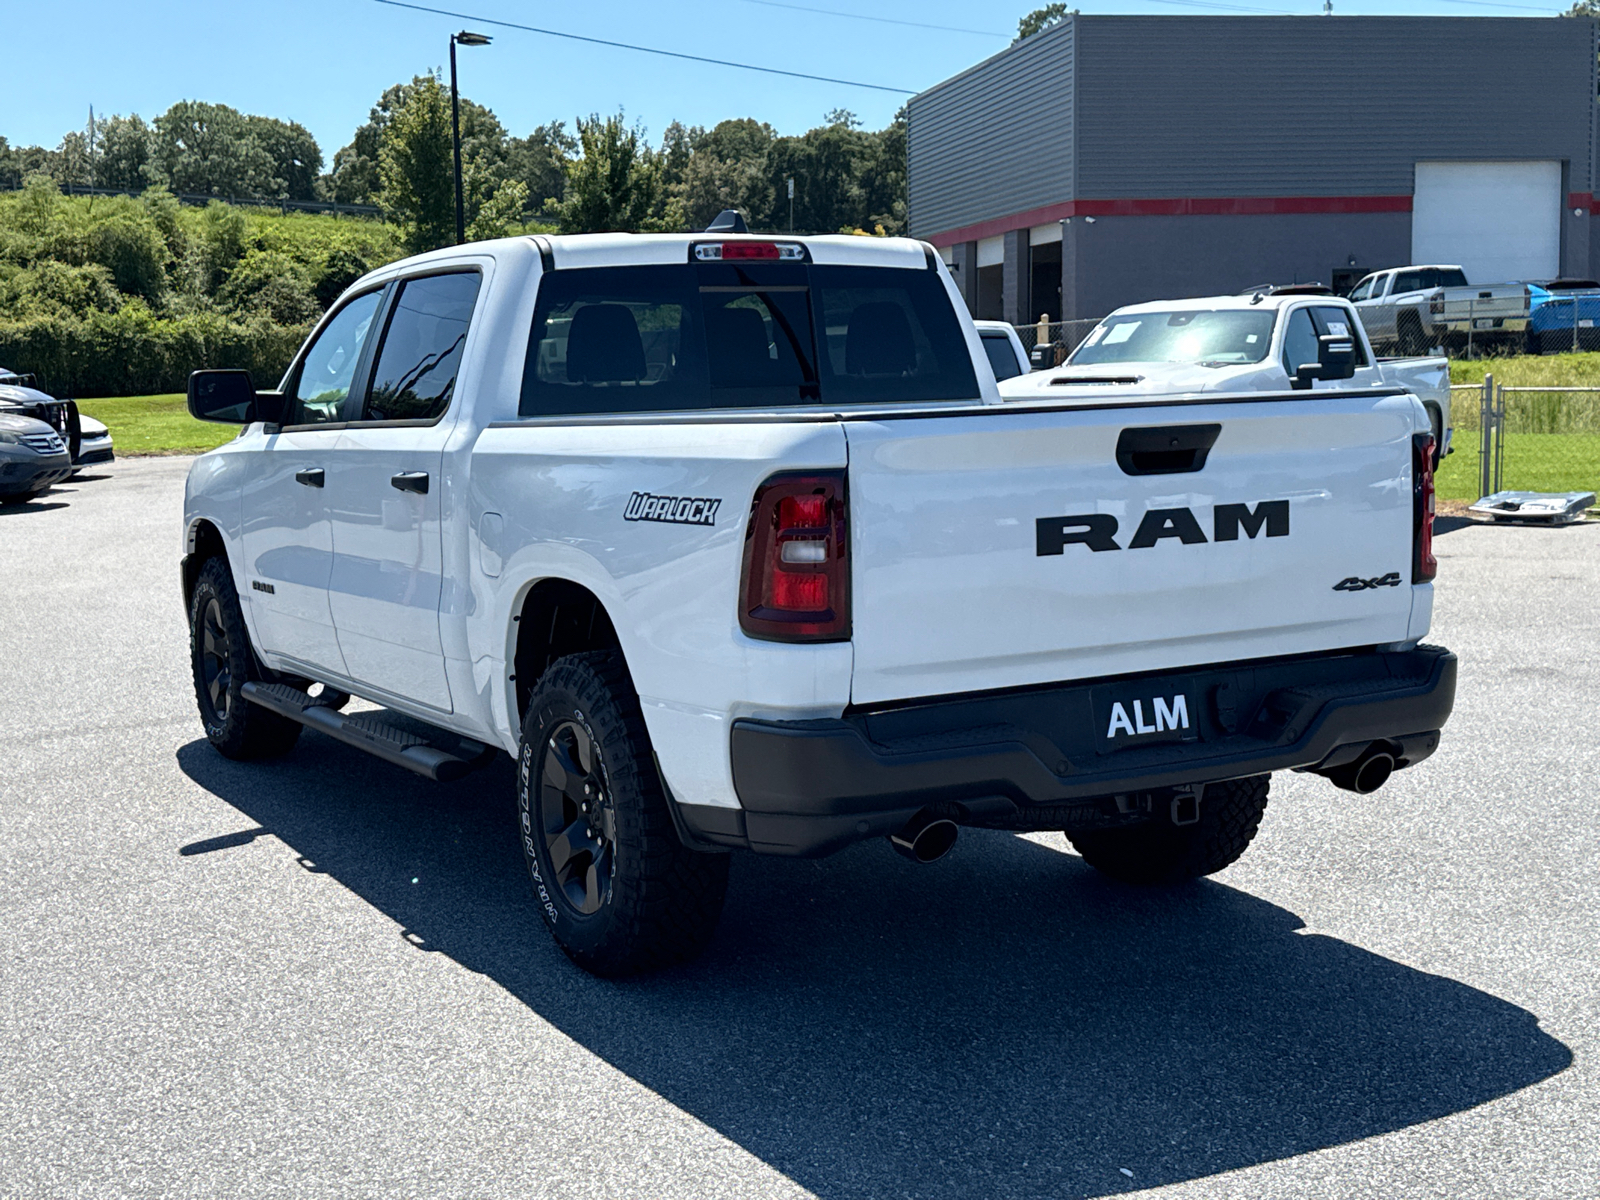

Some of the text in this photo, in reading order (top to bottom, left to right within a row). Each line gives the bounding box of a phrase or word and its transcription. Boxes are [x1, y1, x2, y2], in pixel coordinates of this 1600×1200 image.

[624, 491, 722, 526] WARLOCK
[1036, 500, 1290, 557] RAM
[1332, 572, 1402, 592] 4x4
[1107, 694, 1190, 738] ALM
